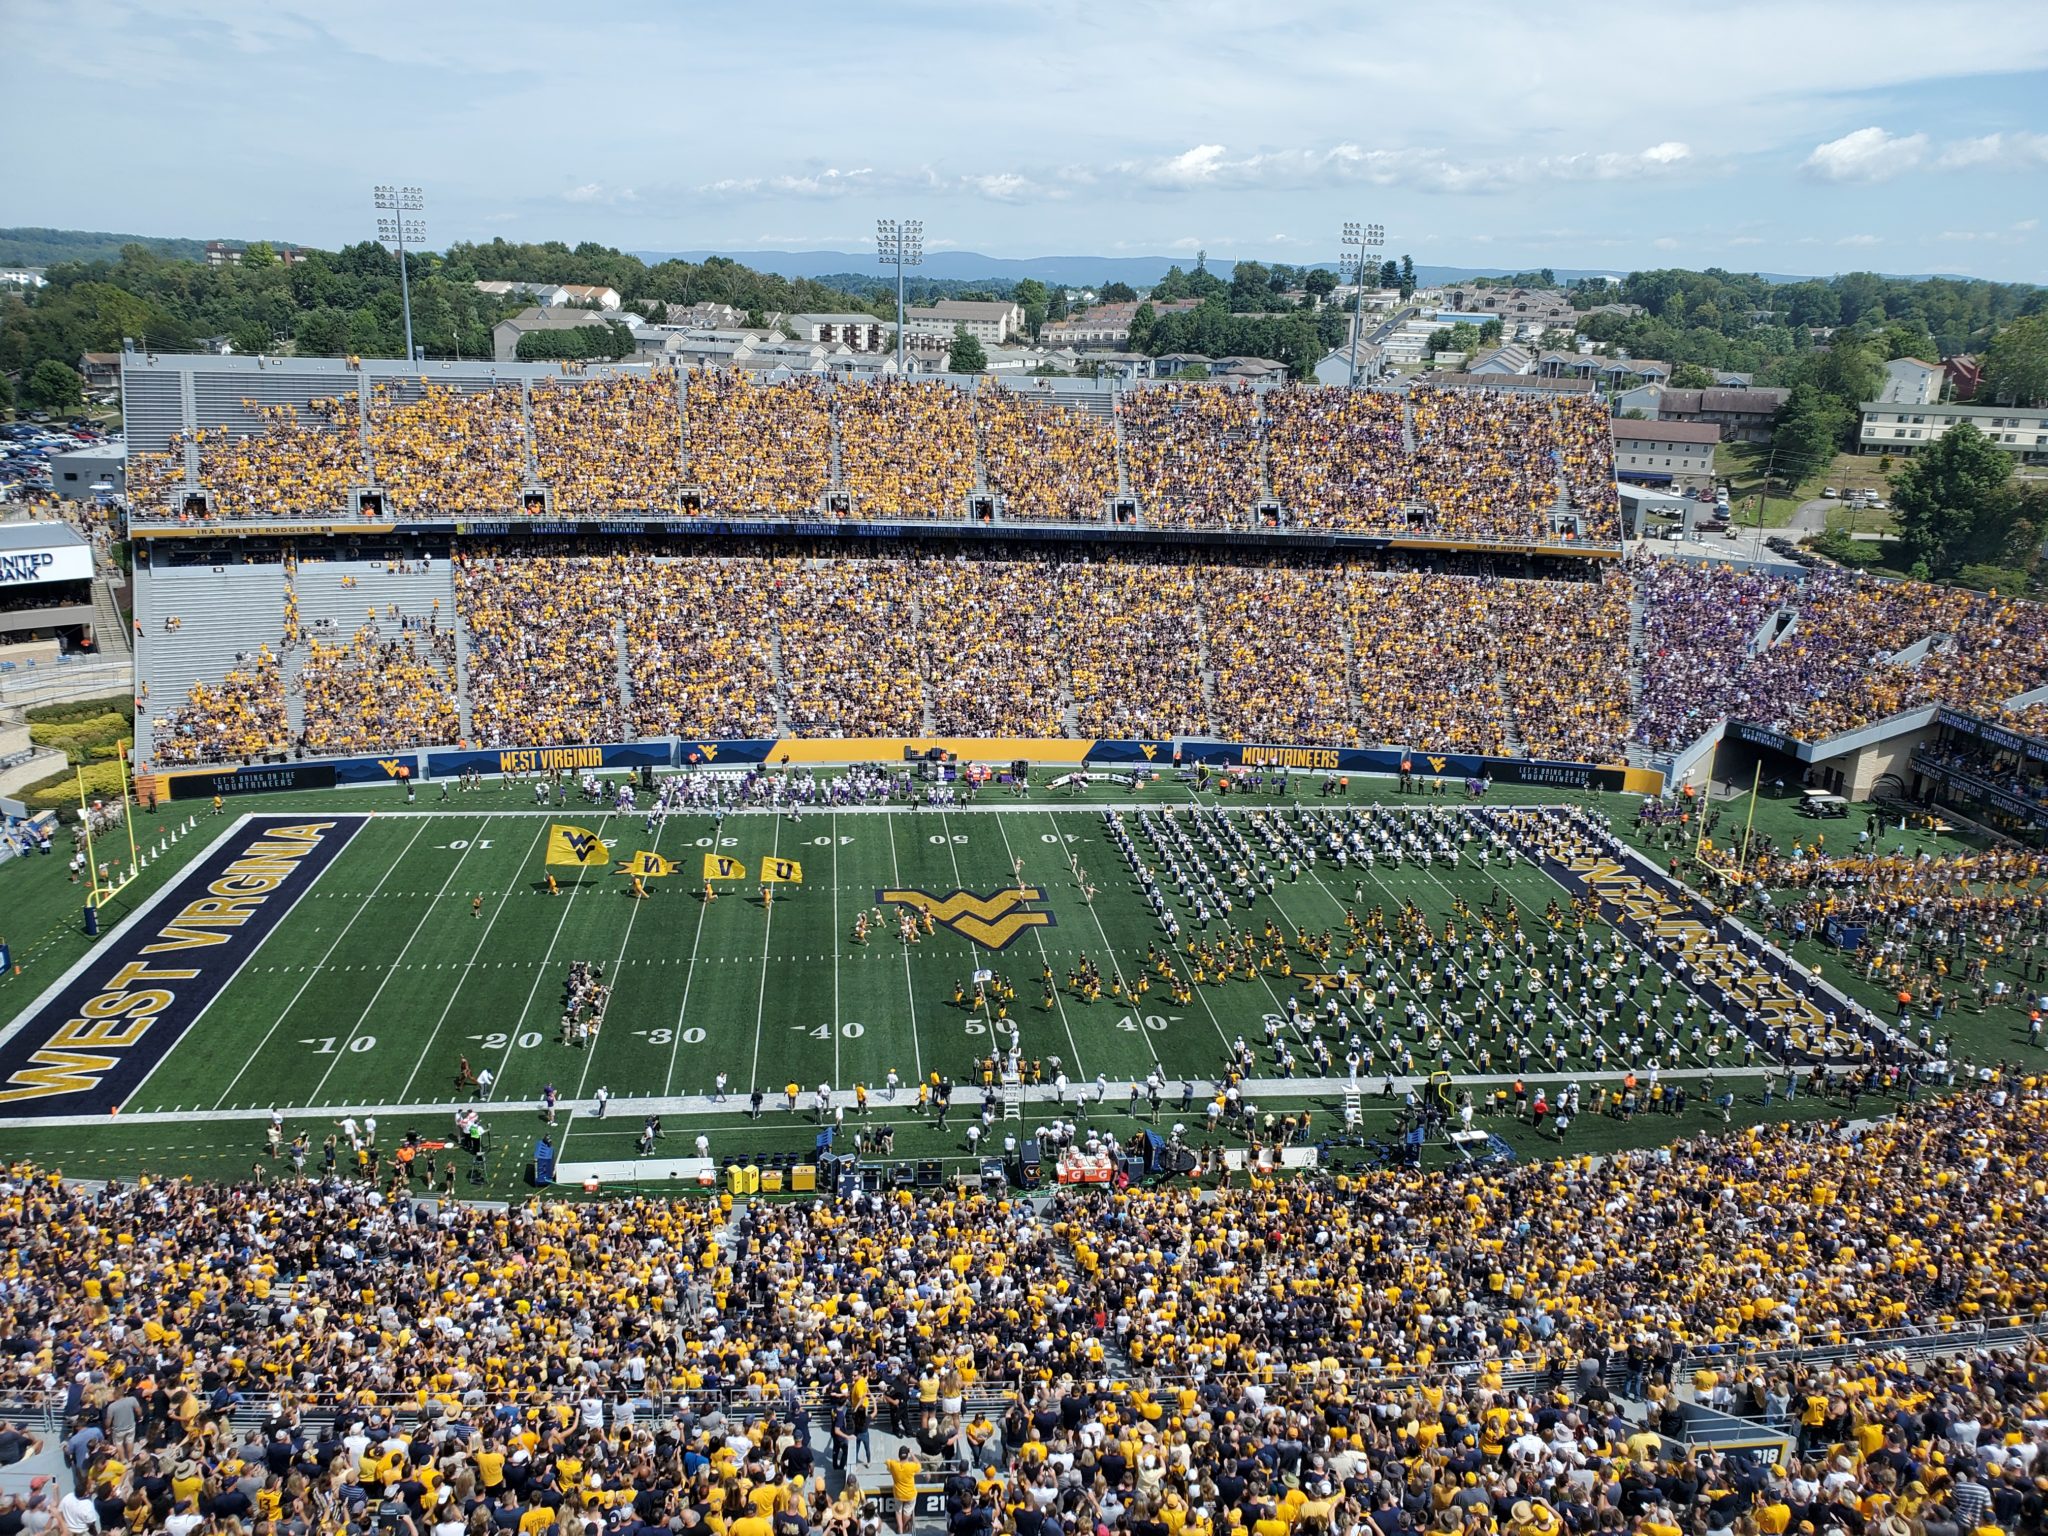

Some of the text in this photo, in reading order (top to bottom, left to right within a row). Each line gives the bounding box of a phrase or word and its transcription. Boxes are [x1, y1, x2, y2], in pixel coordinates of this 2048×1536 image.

[0, 553, 53, 569] NITED
[500, 748, 602, 771] WEST VIRGINIA
[1242, 746, 1339, 768] MOUNTAINEERS
[213, 776, 235, 784] LET'S
[240, 774, 264, 782] BRING
[268, 772, 277, 780] ON
[1519, 766, 1538, 774] LET'S
[1541, 768, 1562, 776] BRING
[1521, 773, 1586, 784] MOUNTAINEERS
[217, 778, 292, 791] MOUNTAINEERS
[718, 859, 734, 876] V
[776, 862, 793, 880] U
[0, 822, 338, 1102] WEST VIRGINIA
[810, 1022, 865, 1039] 40
[964, 1018, 1018, 1034] 50
[1116, 1015, 1168, 1032] 40
[481, 1031, 543, 1049] 20
[648, 1027, 706, 1044] 30
[312, 1036, 376, 1054] 10
[1072, 1171, 1081, 1180] G
[1099, 1170, 1108, 1180] G
[926, 1496, 949, 1512] 21
